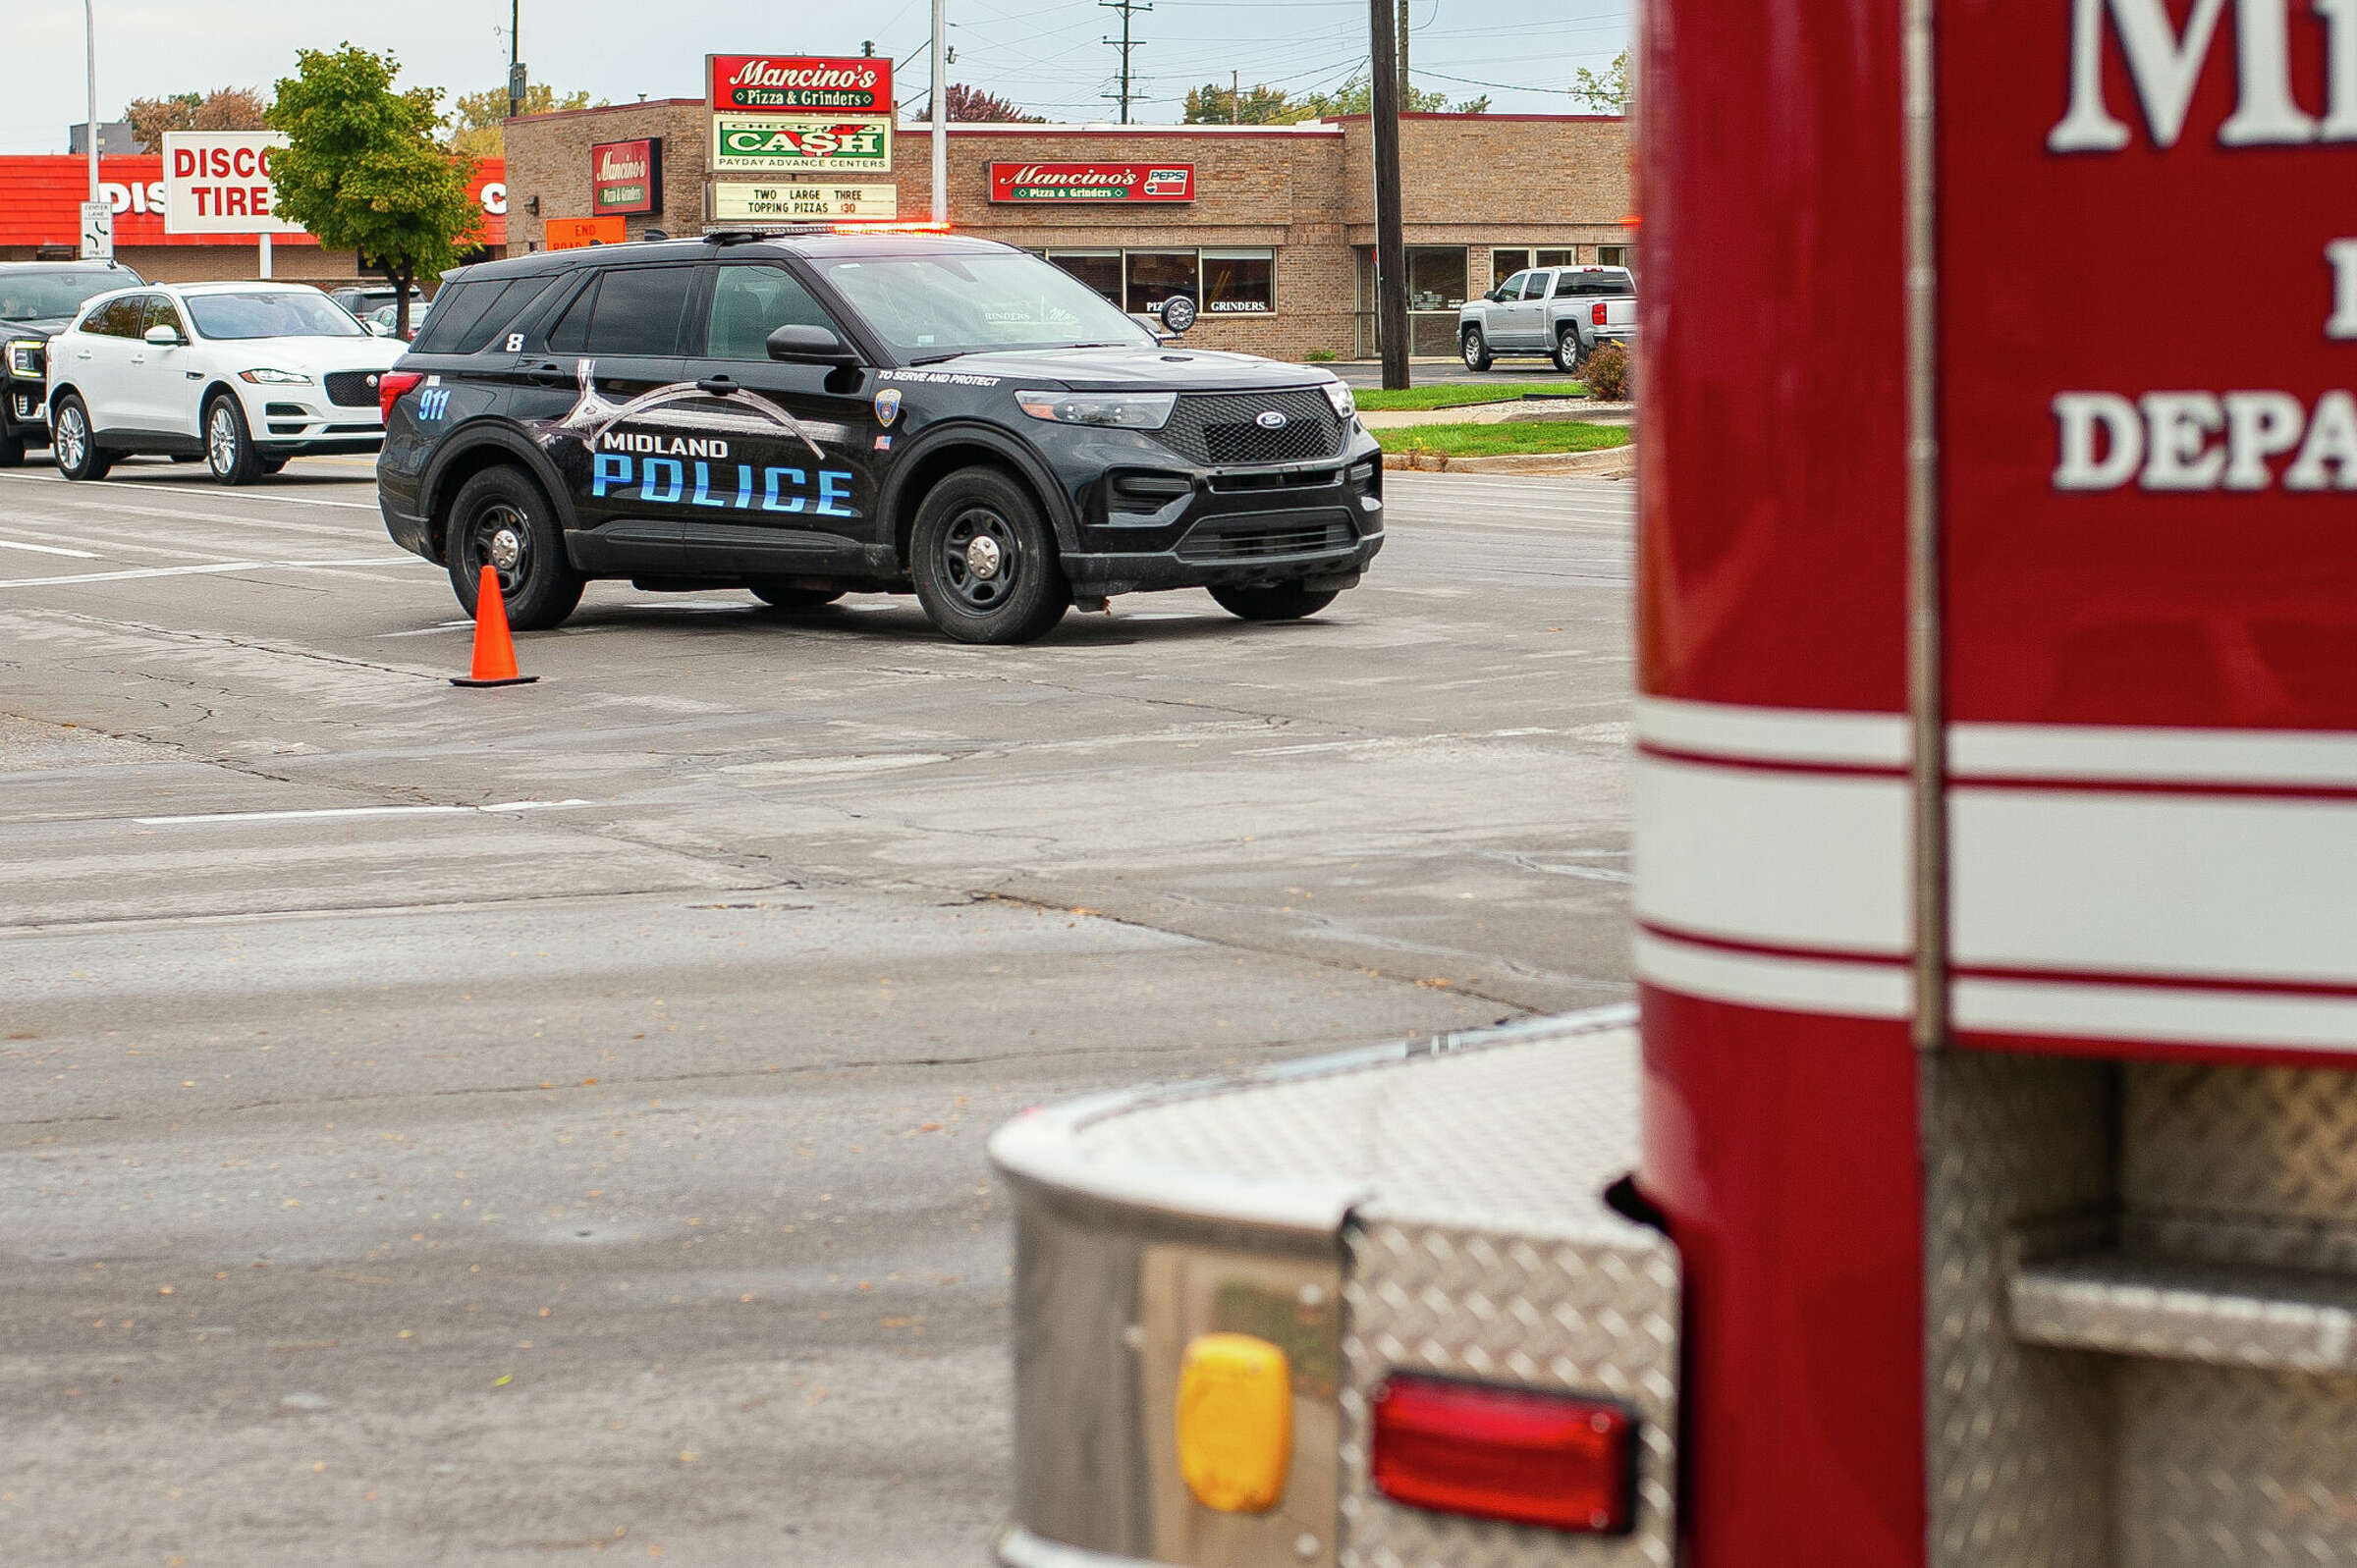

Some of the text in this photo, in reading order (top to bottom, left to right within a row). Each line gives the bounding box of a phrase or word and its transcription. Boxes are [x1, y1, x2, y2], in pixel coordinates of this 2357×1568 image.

[729, 60, 879, 88] Mancino's
[747, 90, 861, 106] Pizza & Grinders
[596, 150, 647, 182] Mancino's
[768, 158, 826, 167] ADVANCE
[830, 159, 886, 168] CENTERS
[1000, 165, 1139, 186] Mancino's
[1150, 171, 1186, 181] PEPSI
[192, 187, 270, 216] TIRE
[754, 189, 862, 200] TWO LARGE THREE
[1029, 188, 1112, 197] Pizza & Grinders
[747, 202, 789, 213] TOPPING
[794, 202, 829, 213] PIZZAS
[575, 224, 596, 237] END
[1211, 301, 1266, 311] GRINDERS
[506, 333, 524, 351] 8
[878, 369, 1002, 387] TO SERVE AND PROTECT
[418, 388, 451, 421] 911
[603, 431, 729, 459] MIDLAND
[2051, 391, 2357, 491] DEPA
[592, 453, 852, 517] POLICE
